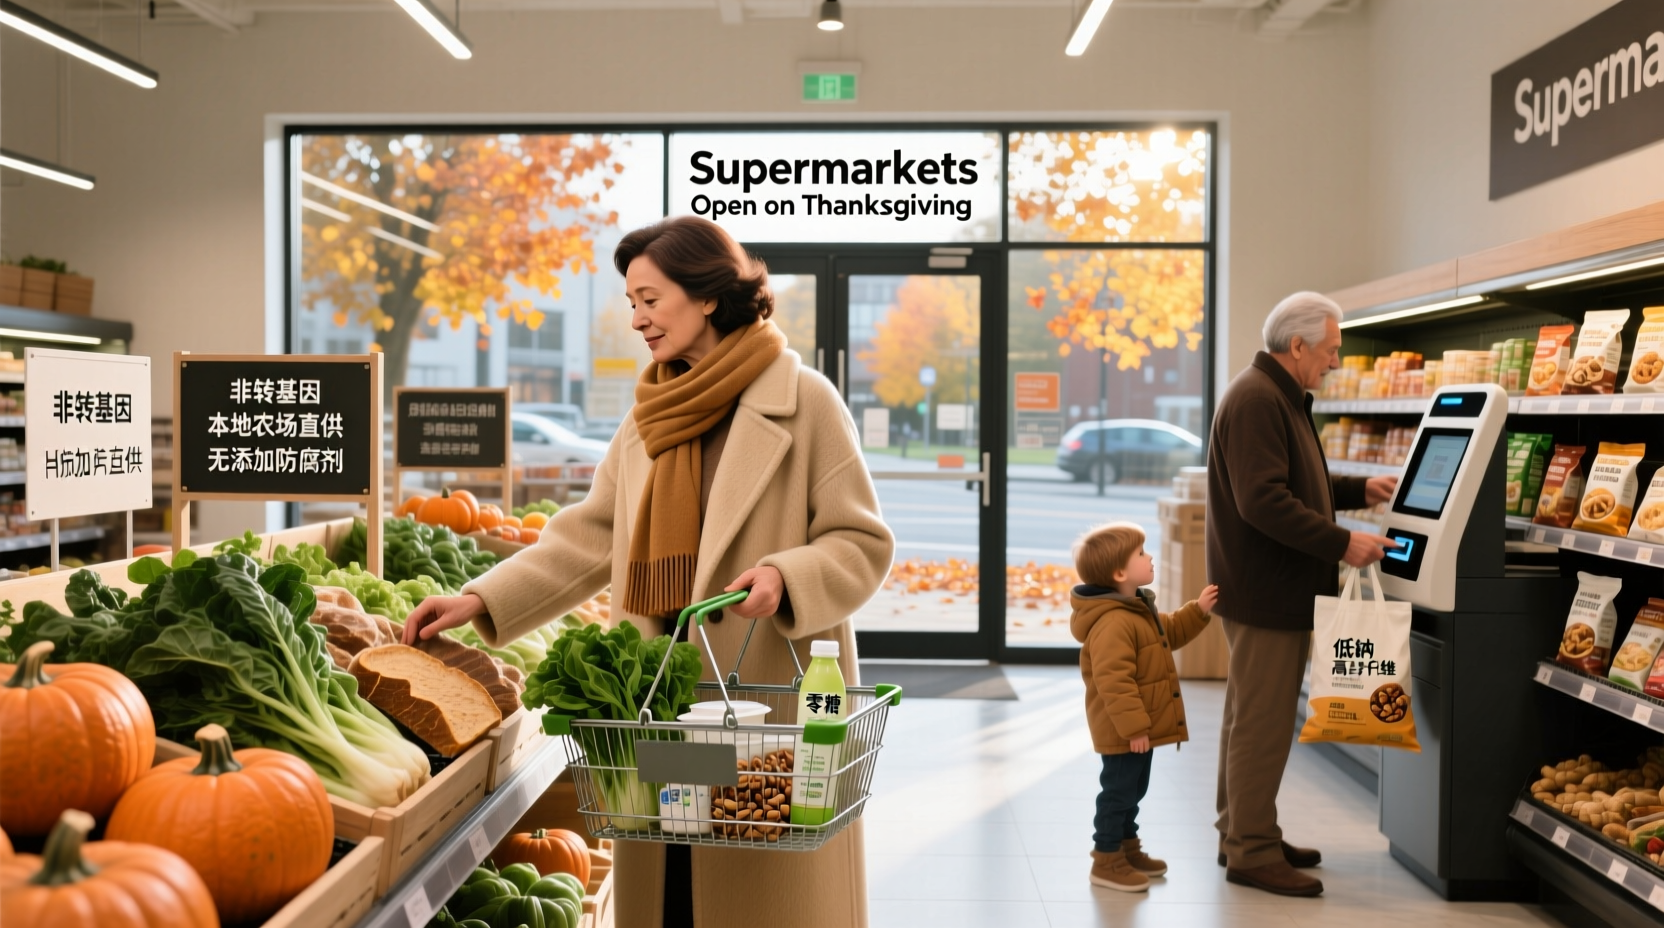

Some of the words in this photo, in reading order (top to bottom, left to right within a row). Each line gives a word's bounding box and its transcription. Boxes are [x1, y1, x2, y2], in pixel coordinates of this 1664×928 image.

[690, 149, 978, 193] Supermarkets
[691, 194, 757, 220] Open
[764, 199, 795, 215] on
[802, 194, 971, 221] Thanksgiving
[229, 378, 320, 404] 非转基因
[53, 390, 131, 424] 非转基因
[208, 412, 343, 438] 本地农场直供
